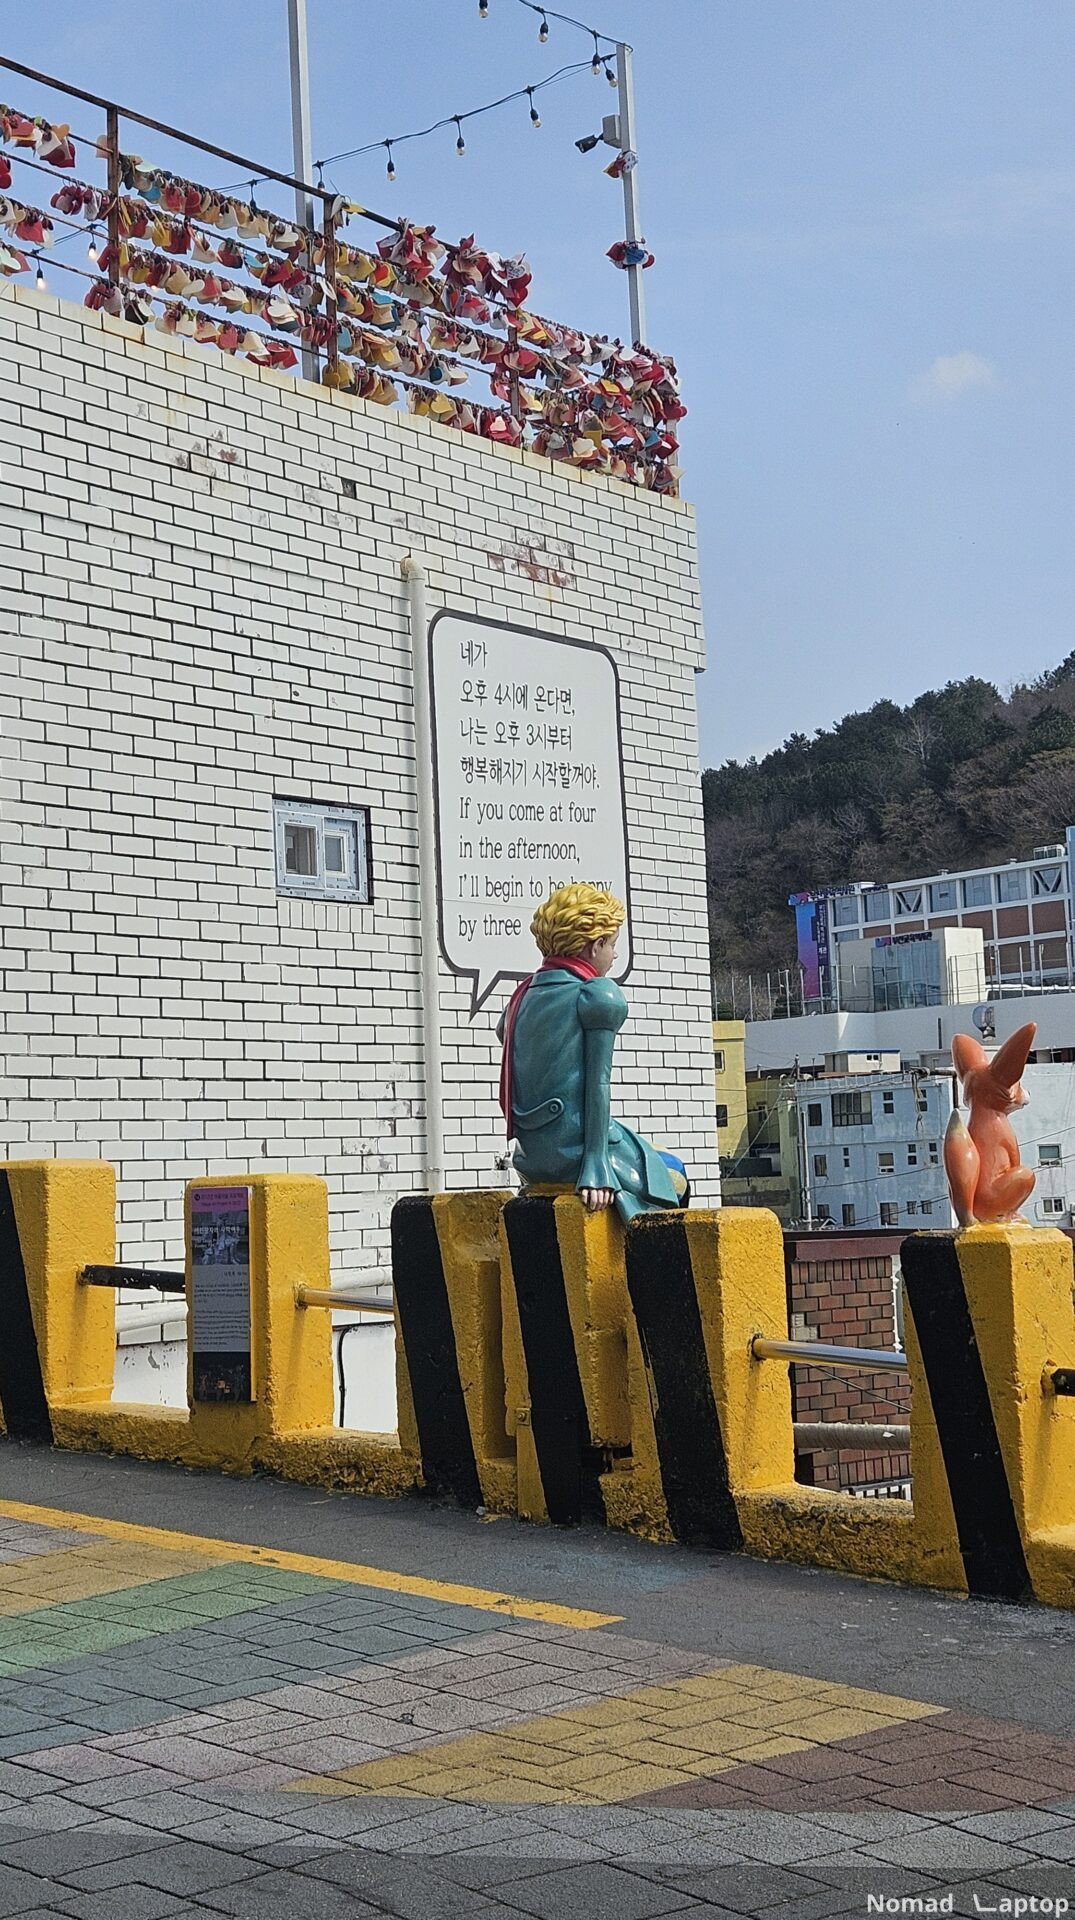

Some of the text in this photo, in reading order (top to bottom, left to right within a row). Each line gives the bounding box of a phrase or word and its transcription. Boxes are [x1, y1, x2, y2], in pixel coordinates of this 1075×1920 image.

[461, 640, 487, 667] 네가
[461, 680, 574, 716] 오후 4시에 온다면,
[461, 718, 571, 751] 나는 오후 3시부터
[460, 756, 599, 789] 행복해지기 시작할꺼야.
[460, 797, 596, 824] If you come at four
[460, 835, 579, 864] in the afternoon,
[485, 875, 523, 902] begin
[529, 877, 543, 897] to
[459, 914, 521, 941] by three
